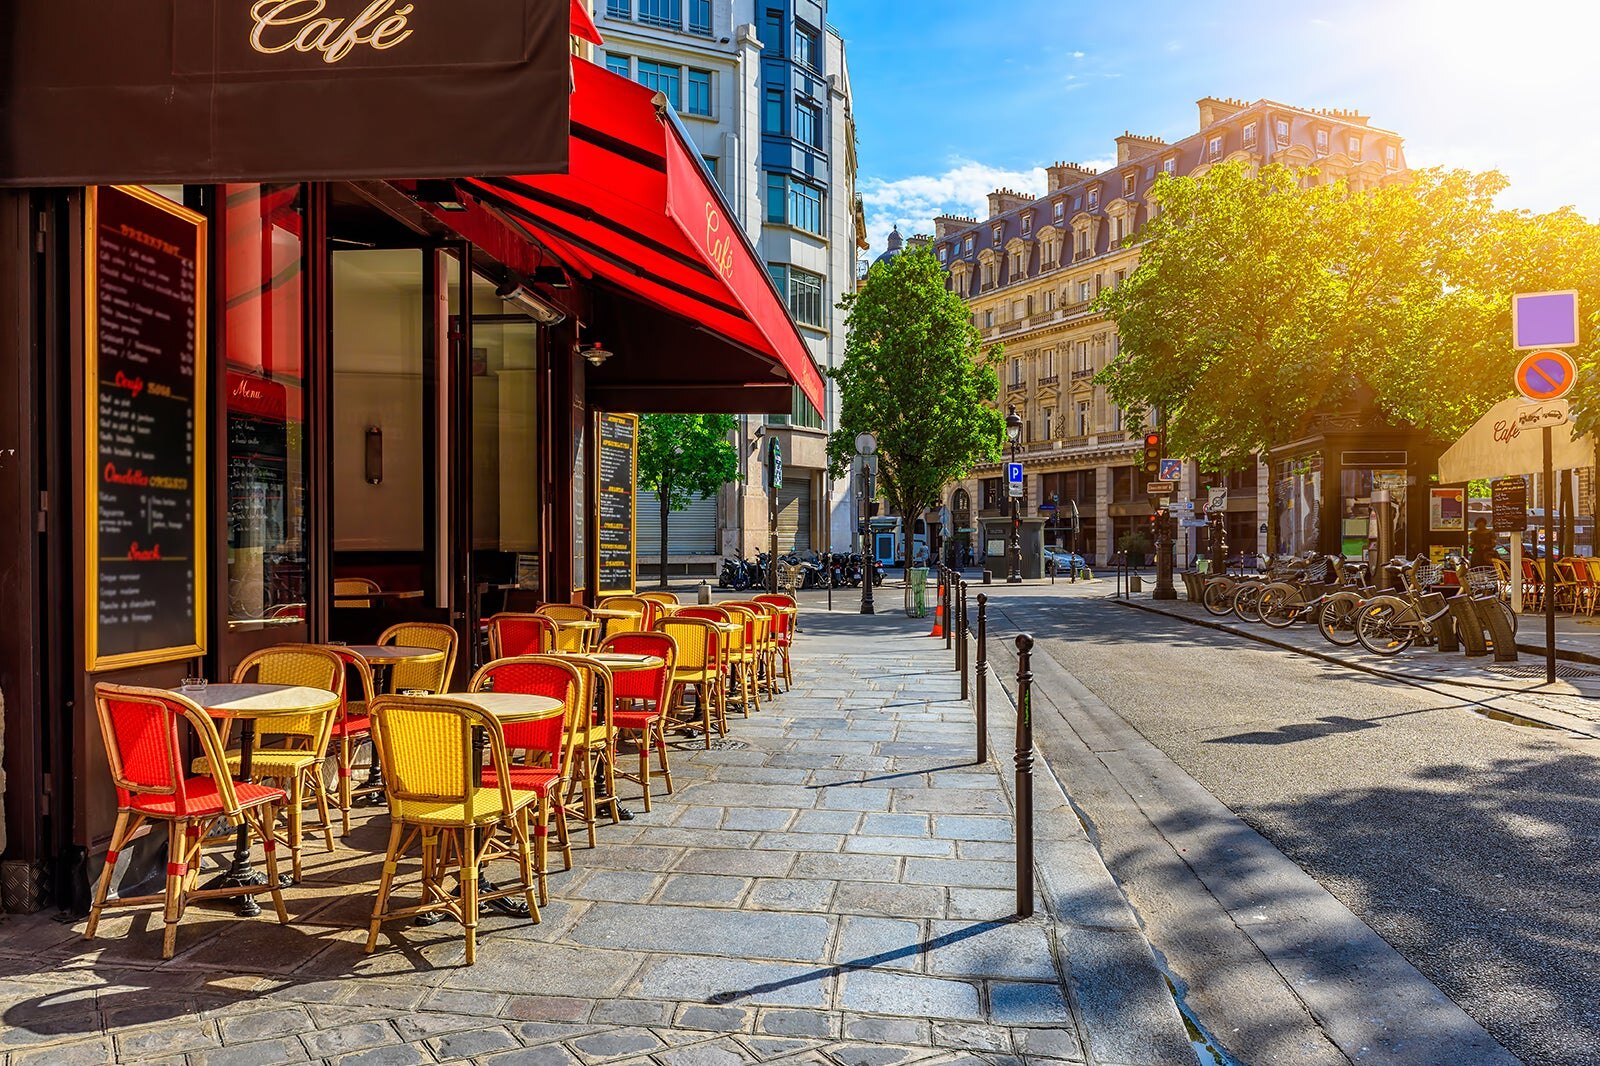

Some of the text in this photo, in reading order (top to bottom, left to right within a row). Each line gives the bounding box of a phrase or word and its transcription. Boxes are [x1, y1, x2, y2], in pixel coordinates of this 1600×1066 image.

[250, 0, 415, 63] Café
[706, 201, 733, 279] Café
[233, 379, 261, 399] Menu
[1012, 467, 1019, 479] P
